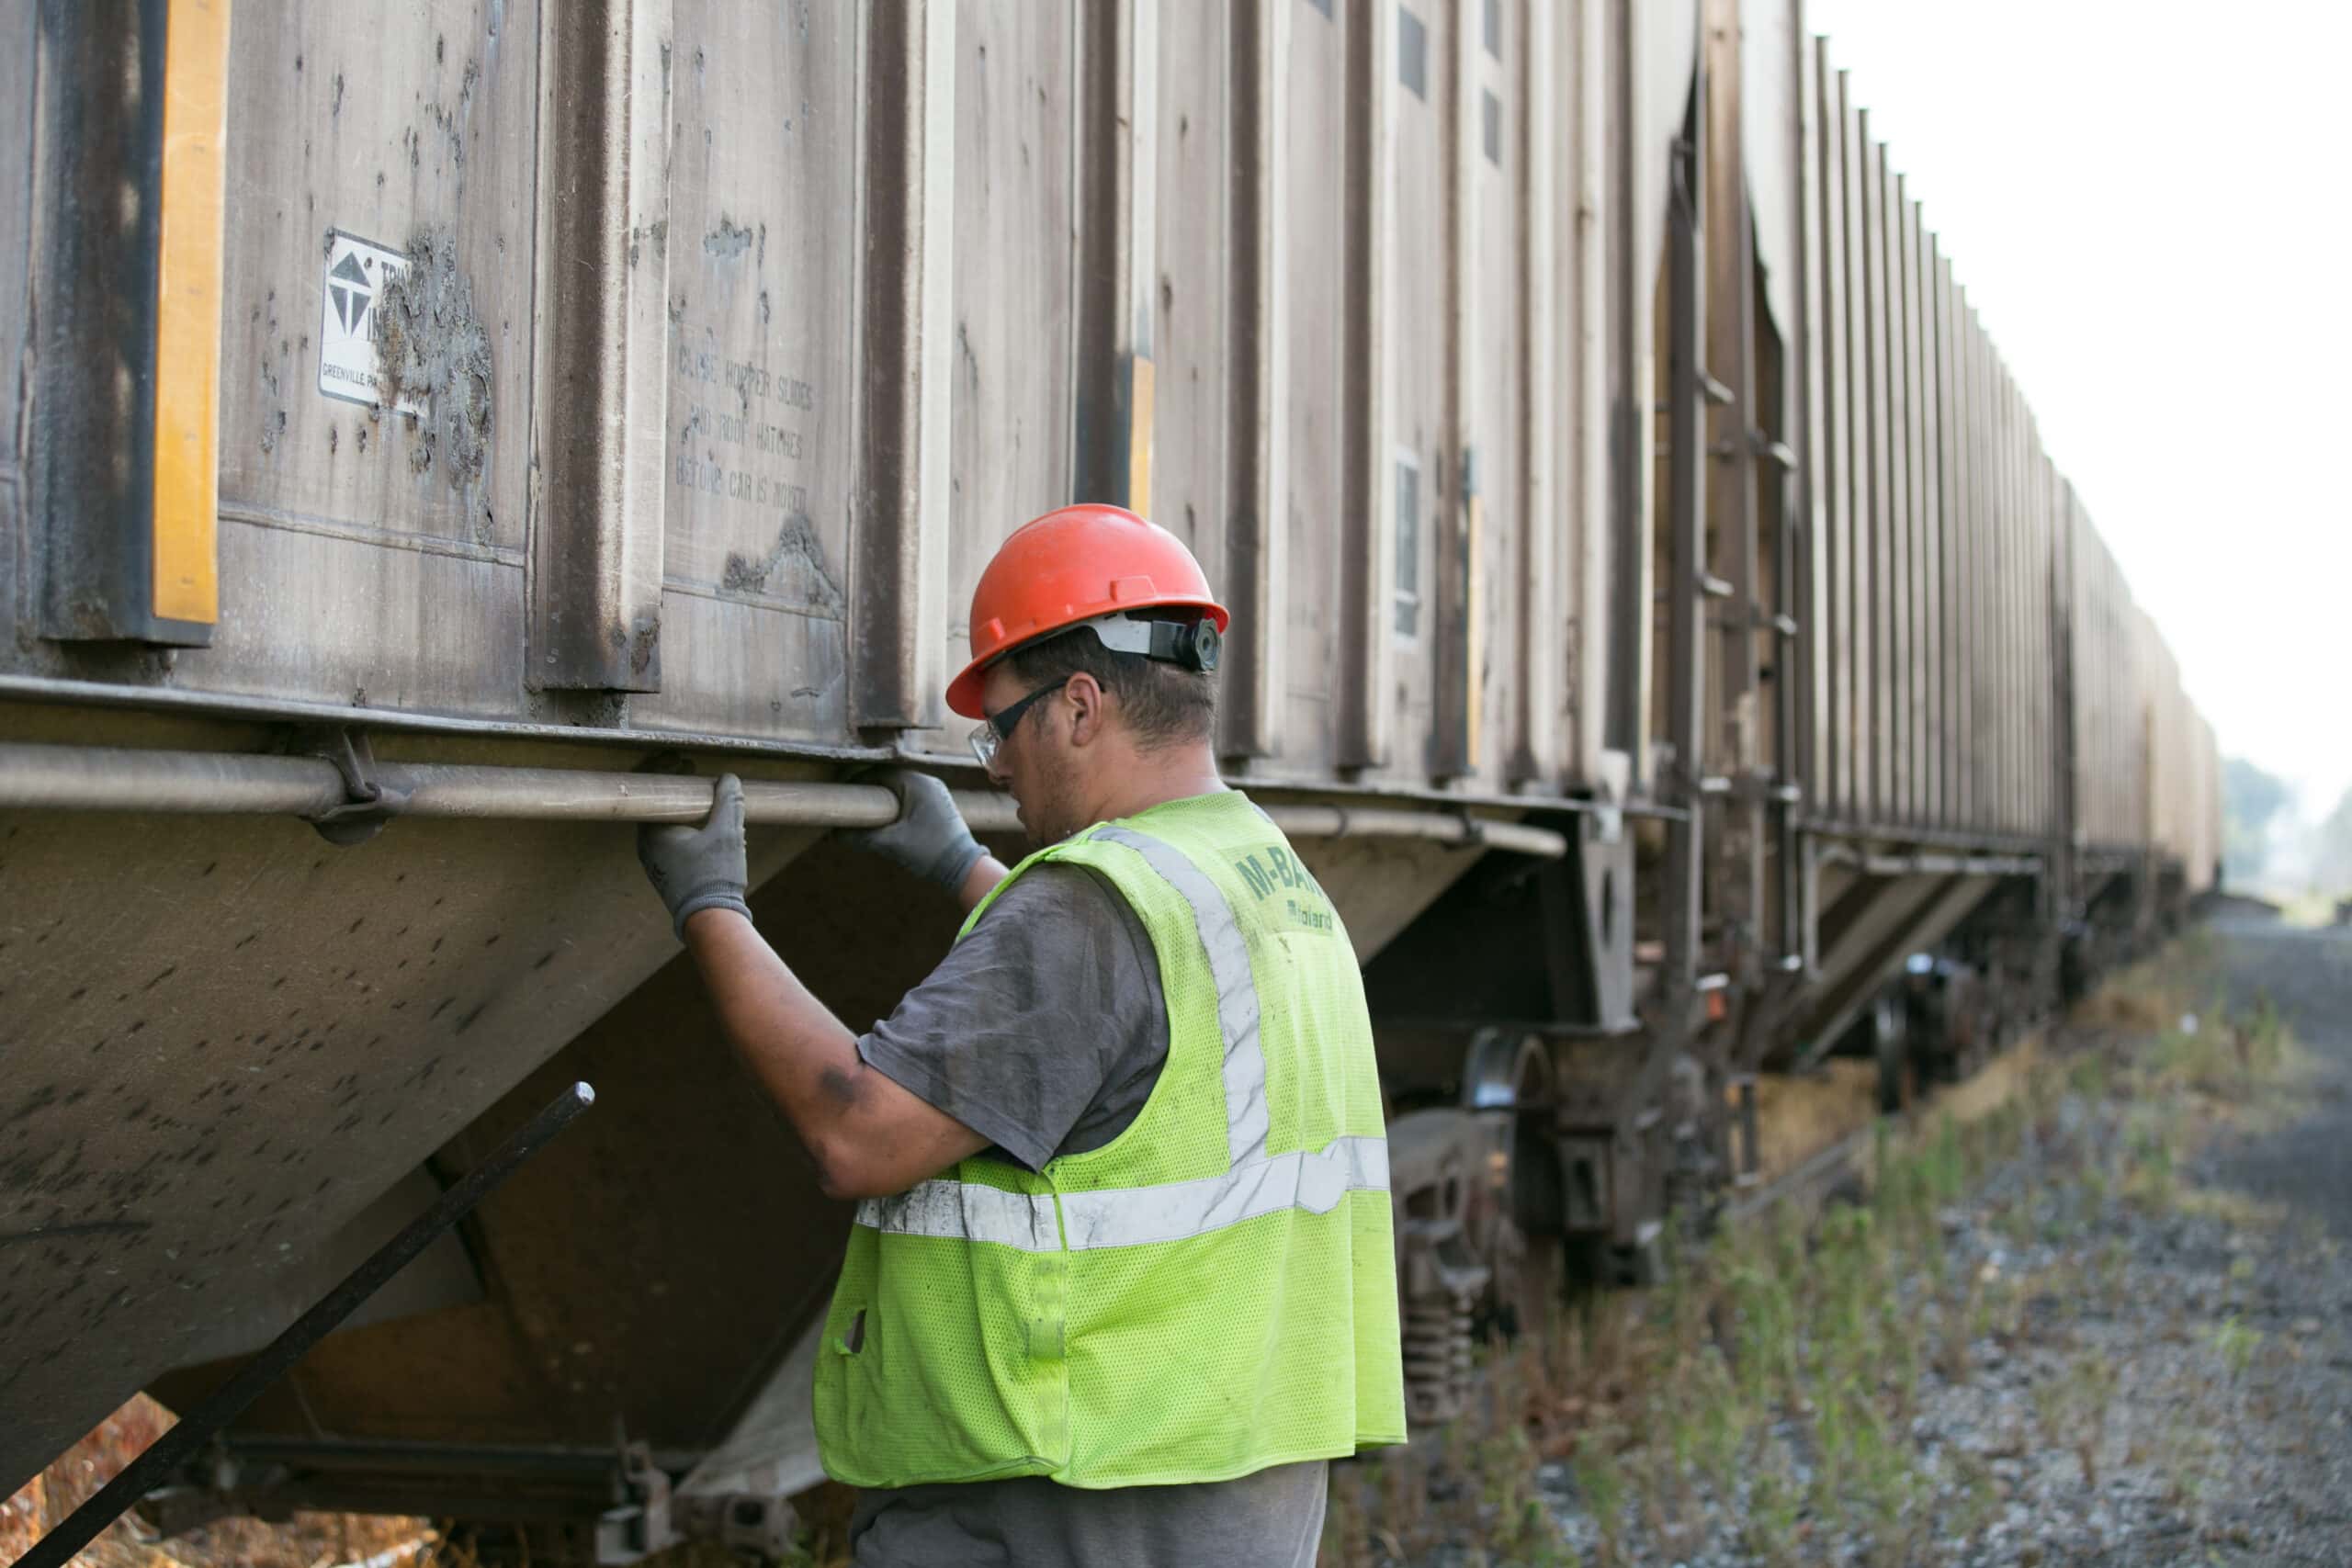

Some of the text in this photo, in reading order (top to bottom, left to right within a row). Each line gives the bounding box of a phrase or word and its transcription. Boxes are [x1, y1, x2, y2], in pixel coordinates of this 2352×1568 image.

[322, 363, 366, 386] GREENVILLE
[729, 470, 752, 501] CAR
[757, 477, 767, 503] IS
